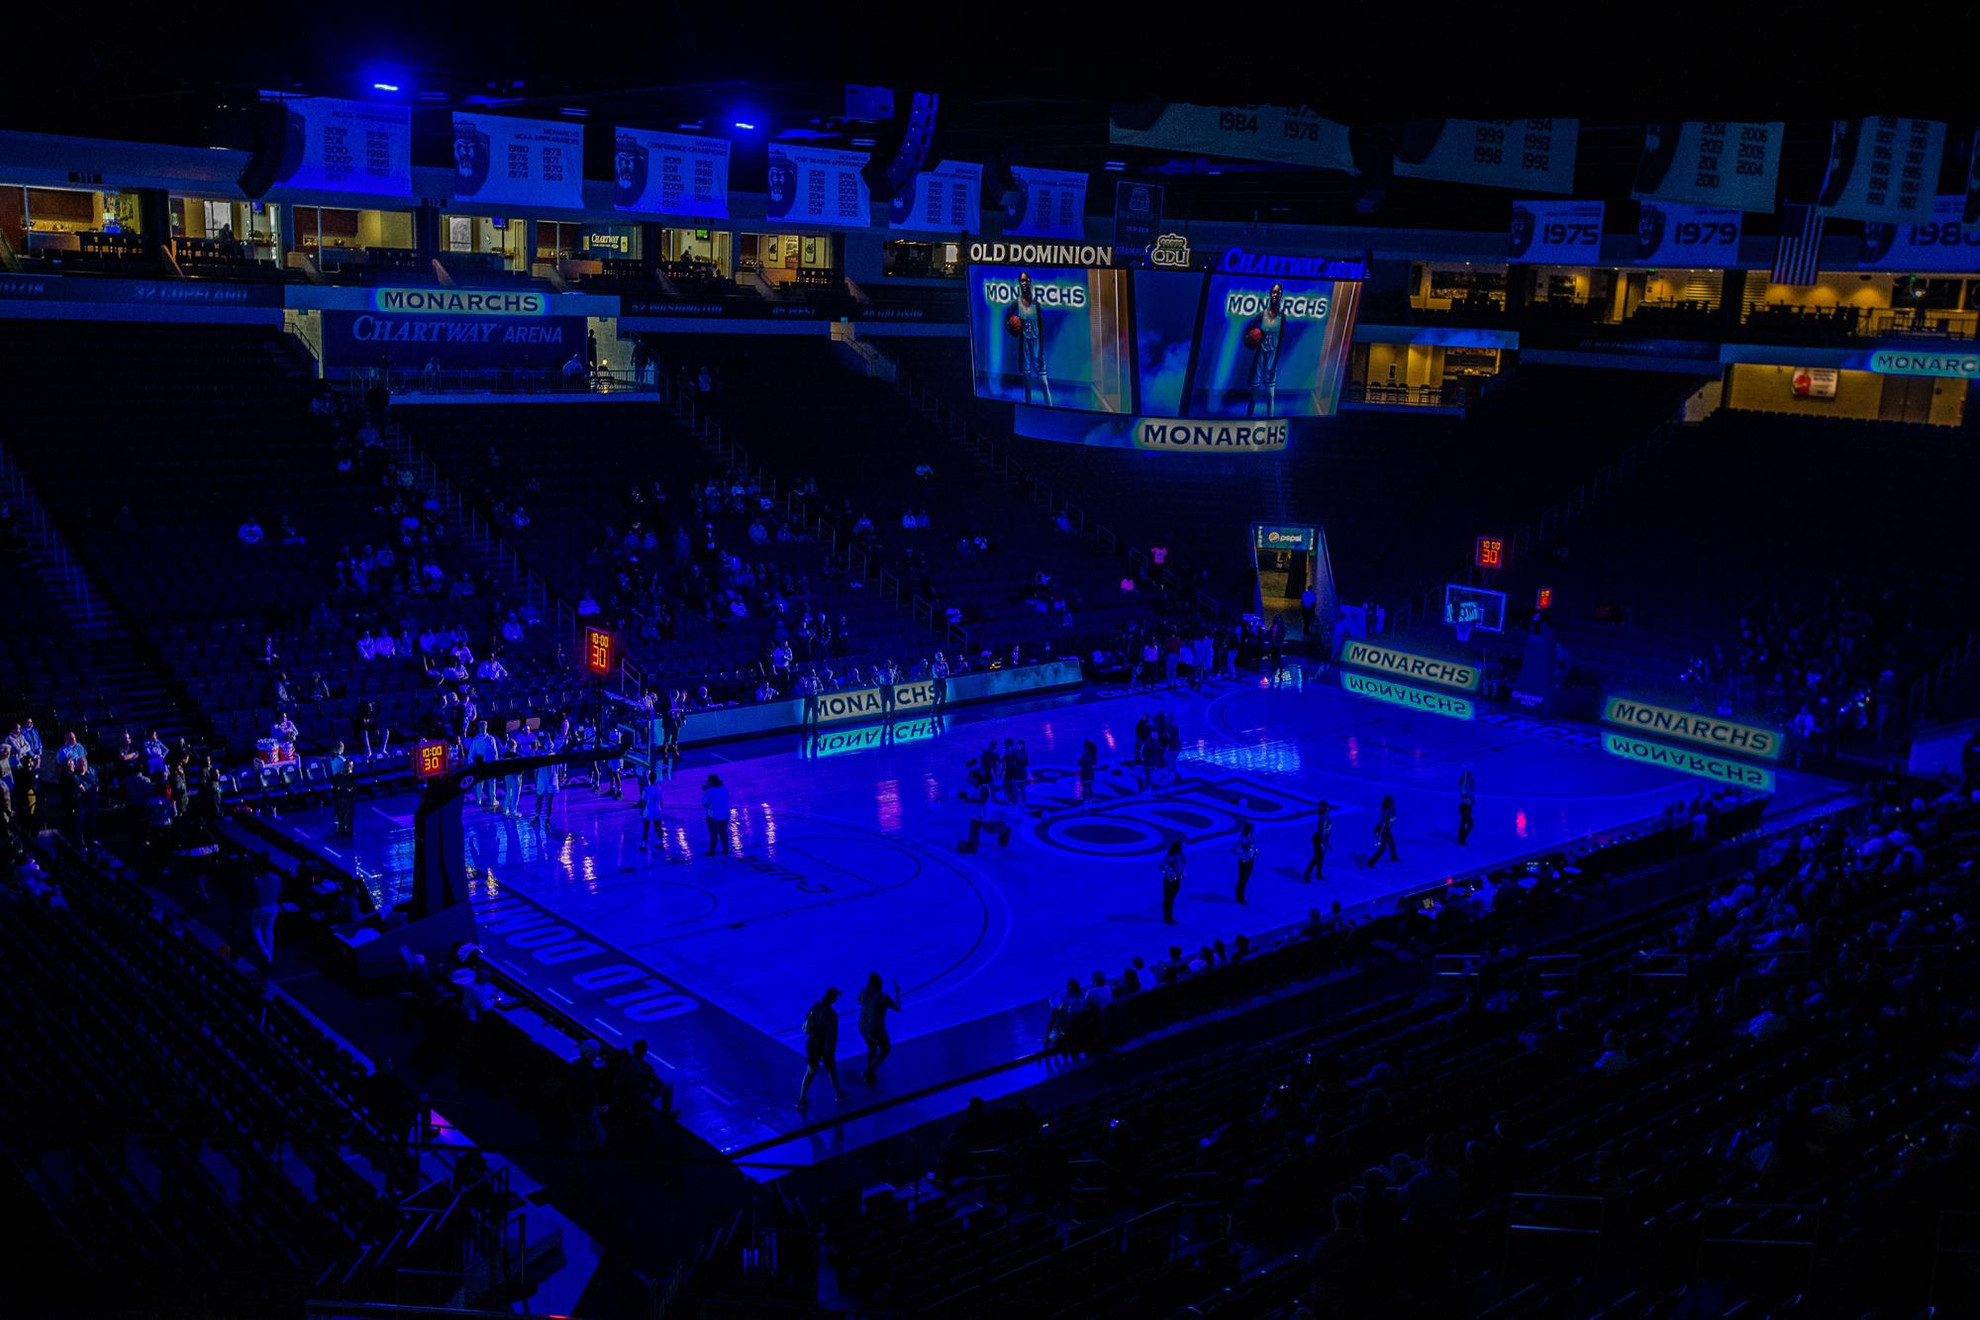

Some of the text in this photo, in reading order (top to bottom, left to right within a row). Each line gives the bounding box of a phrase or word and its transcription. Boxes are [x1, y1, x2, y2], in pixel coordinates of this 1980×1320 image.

[1220, 111, 1257, 134] 1984
[1284, 120, 1319, 141] 1978
[1476, 126, 1504, 144] 1999
[1741, 126, 1768, 142] 2006
[324, 145, 348, 155] 2010
[508, 145, 529, 153] 1980
[1524, 134, 1550, 151] 1993
[1701, 138, 1723, 154] 2013
[324, 155, 353, 164] 2007
[508, 154, 528, 162] 1976
[543, 148, 561, 156] 1973
[1474, 146, 1502, 164] 1998
[1738, 143, 1764, 160] 2005
[543, 156, 558, 164] 1971
[1522, 152, 1549, 171] 1992
[1698, 155, 1717, 170] 2011
[1736, 160, 1763, 176] 2004
[508, 170, 528, 179] 1974
[543, 165, 562, 173] 1970
[543, 173, 563, 181] 1969
[663, 174, 681, 182] 2010
[1696, 172, 1720, 188] 2010
[695, 186, 712, 194] 1977
[1543, 223, 1599, 245] 1975
[1675, 222, 1737, 245] 1979
[970, 244, 1112, 266] OLD DOMINION
[1152, 249, 1190, 268] ODU
[1226, 247, 1322, 276] CHARTWAY
[986, 282, 1086, 305] MONRCHS
[384, 292, 539, 312] MONARCHS
[1228, 296, 1328, 317] MONRCHS
[352, 316, 562, 344] CHARTWAY ARENA
[1878, 356, 1980, 372] MONARC
[1144, 424, 1286, 446] MONARCHS
[1280, 534, 1302, 543] pepsi
[1482, 549, 1498, 564] 30
[592, 632, 609, 647] 10:00
[593, 645, 607, 668] 30
[1351, 646, 1470, 684] MONARCHS
[1616, 704, 1768, 750] MONARCHS
[422, 745, 442, 757] 10:00
[424, 757, 439, 771] 30
[572, 964, 700, 1022] OLD
